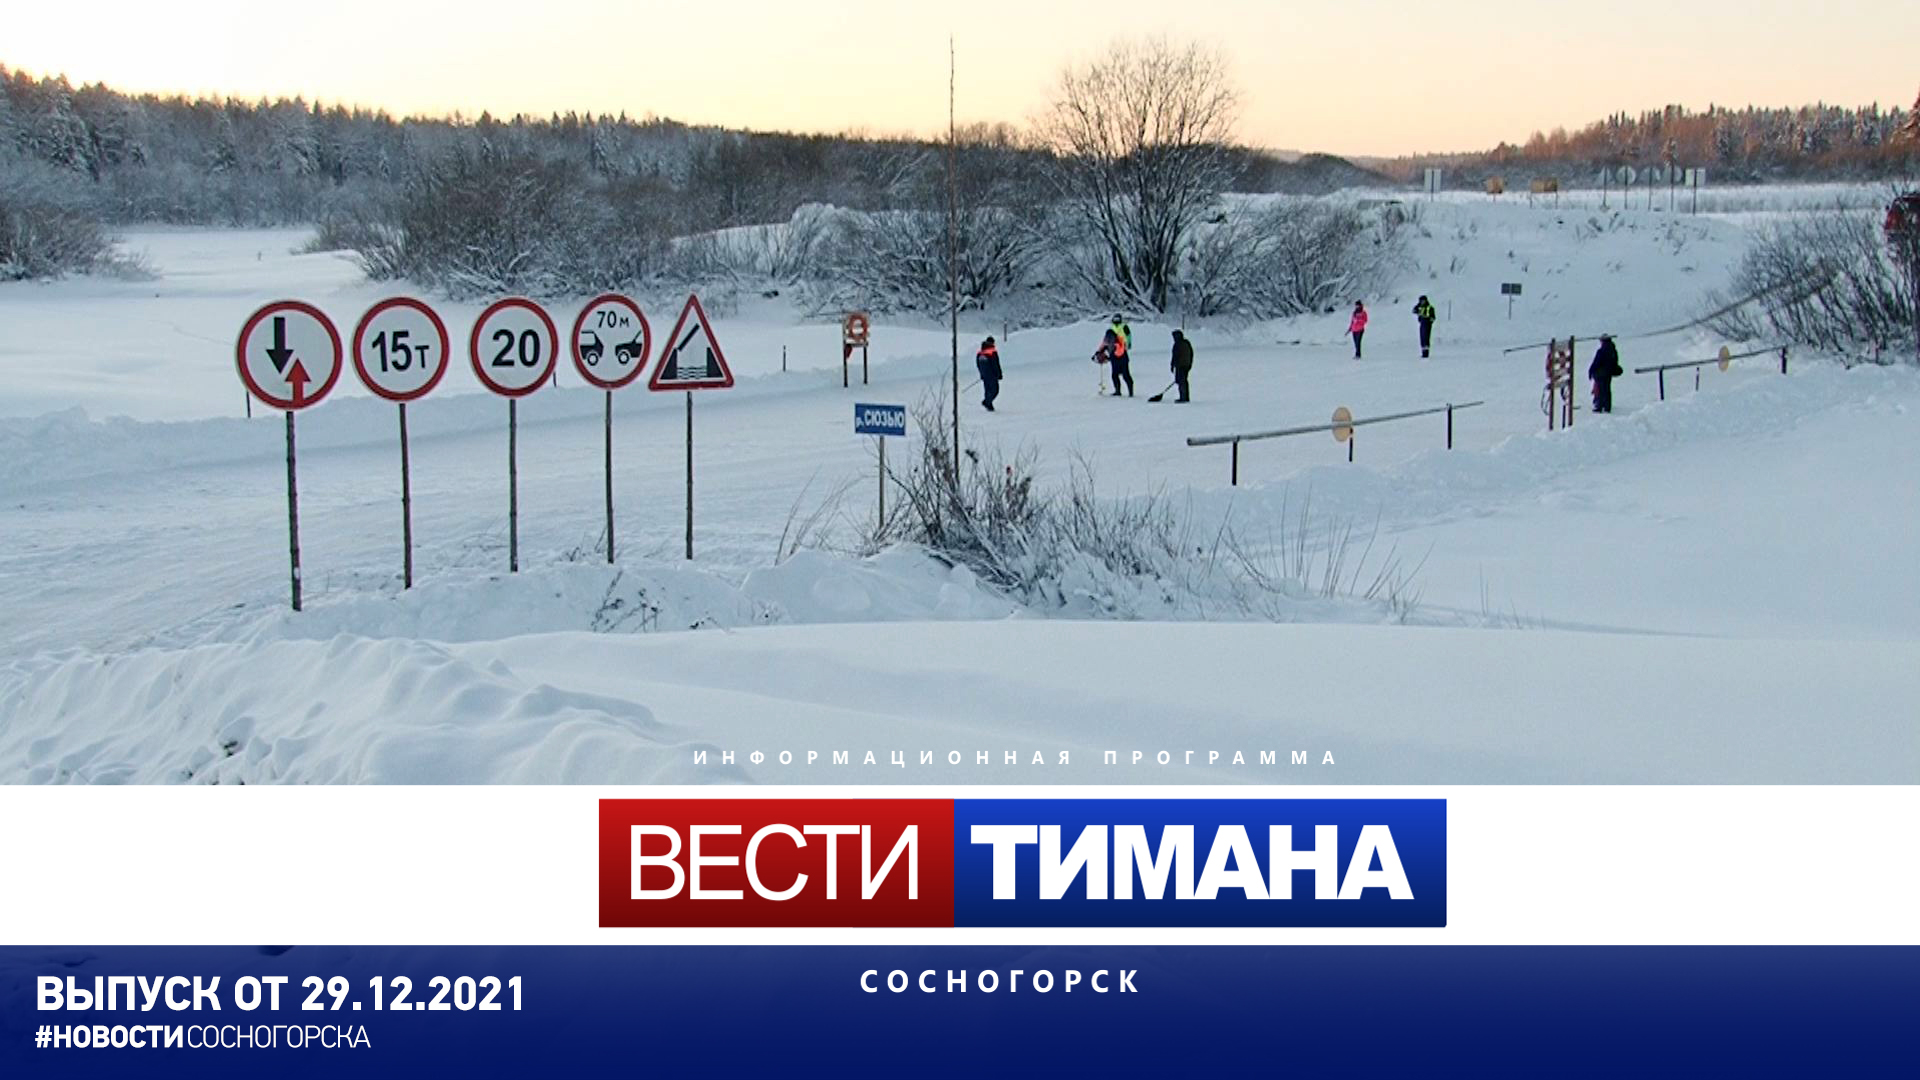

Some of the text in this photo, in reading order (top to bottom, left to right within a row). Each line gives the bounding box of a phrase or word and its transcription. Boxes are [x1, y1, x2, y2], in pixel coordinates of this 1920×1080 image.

[371, 329, 430, 373] 15т
[491, 329, 541, 367] 20
[864, 409, 905, 428] СЮЗЬЮ
